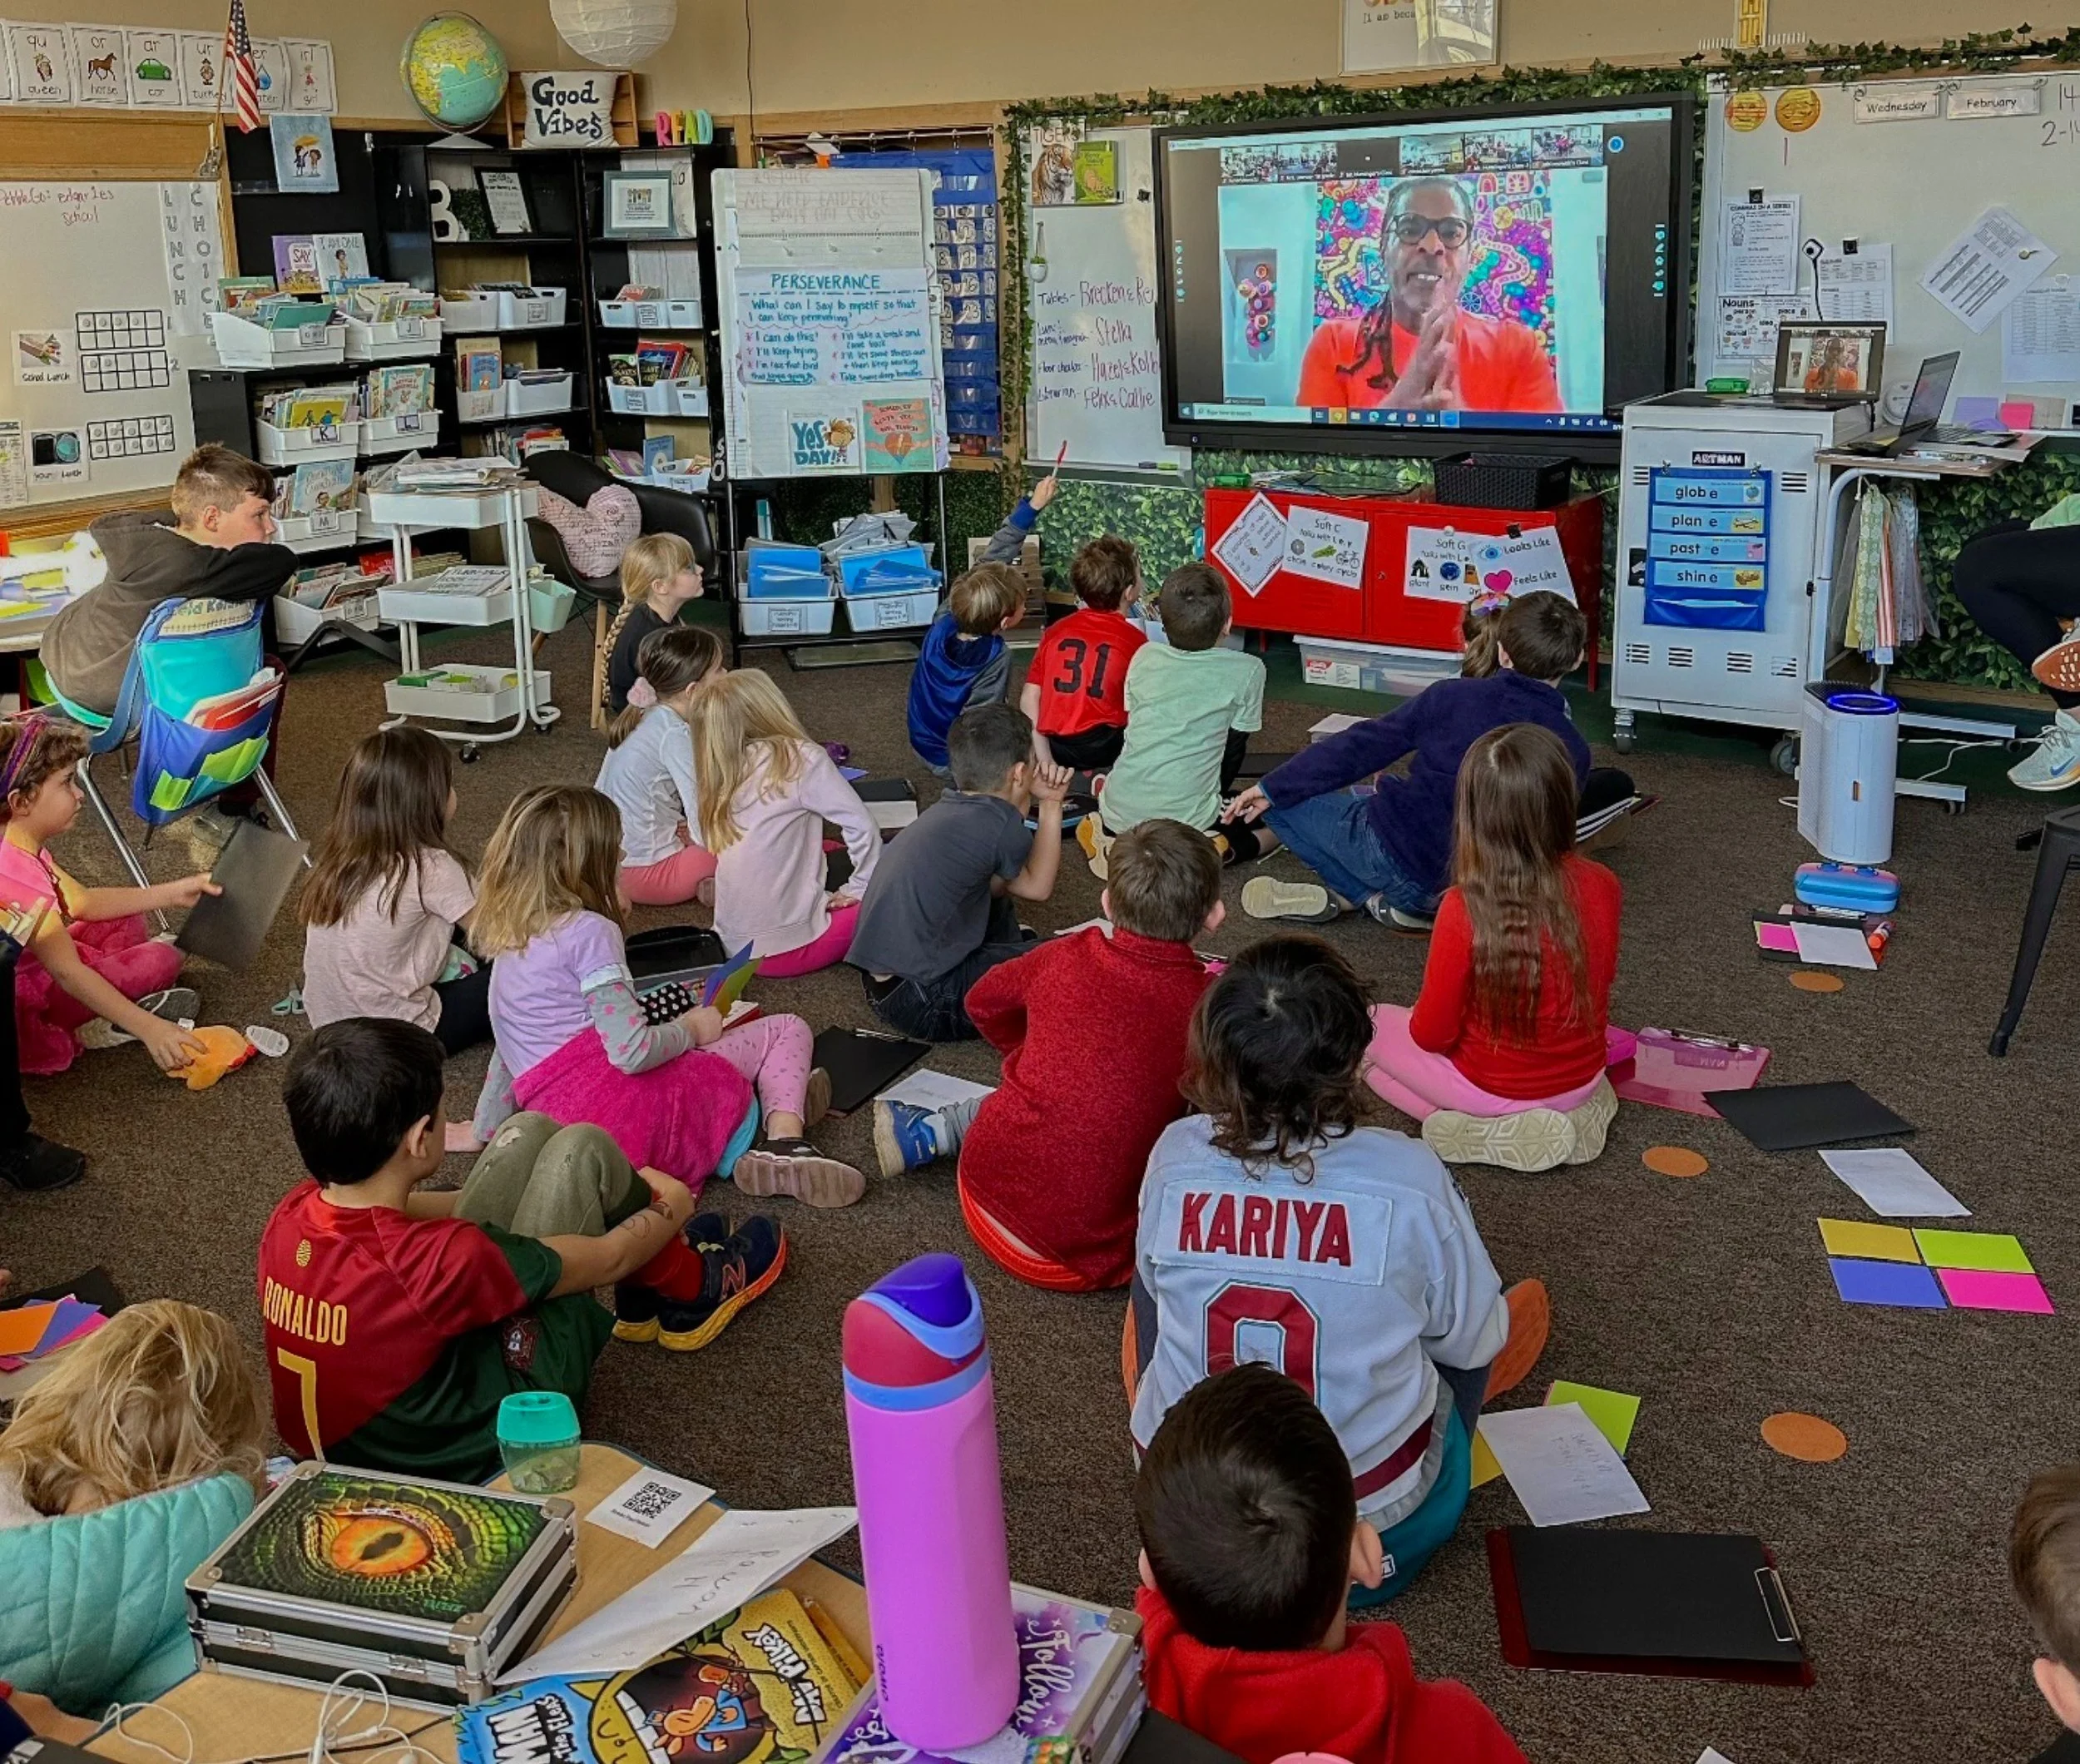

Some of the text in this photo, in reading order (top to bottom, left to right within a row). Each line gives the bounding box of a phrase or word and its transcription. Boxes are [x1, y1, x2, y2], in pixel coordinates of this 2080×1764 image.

[27, 35, 47, 50] qu
[91, 36, 106, 50] or
[143, 40, 161, 52] ar
[196, 42, 213, 56] ur
[91, 85, 118, 96] horse
[532, 77, 599, 107] Good
[259, 93, 278, 104] ater
[1966, 97, 2018, 110] February
[1867, 100, 1928, 114] Wednesday
[535, 108, 603, 140] Vibes
[654, 109, 713, 146] READ
[1033, 127, 1081, 144] TIGERS
[62, 208, 100, 226] school
[771, 273, 880, 290] PERSEVERANCE
[752, 300, 779, 310] What
[785, 301, 802, 310] can
[816, 300, 833, 313] say
[838, 300, 845, 310] to
[849, 300, 879, 314] myself
[896, 300, 916, 309] that
[1723, 298, 1755, 308] Nouns
[759, 314, 774, 322] can
[1096, 316, 1132, 346] Stella
[794, 448, 836, 466] DAY!
[1693, 453, 1742, 465] ARTMAN
[1335, 524, 1341, 533] C
[1436, 538, 1455, 548] Soft
[1503, 538, 1552, 555] Looks Like
[1513, 571, 1558, 586] Feels Like
[1054, 638, 1112, 699] 31
[1179, 1192, 1352, 1268] KARIYA
[264, 1276, 348, 1345] RONALDO
[277, 1346, 327, 1462] 7
